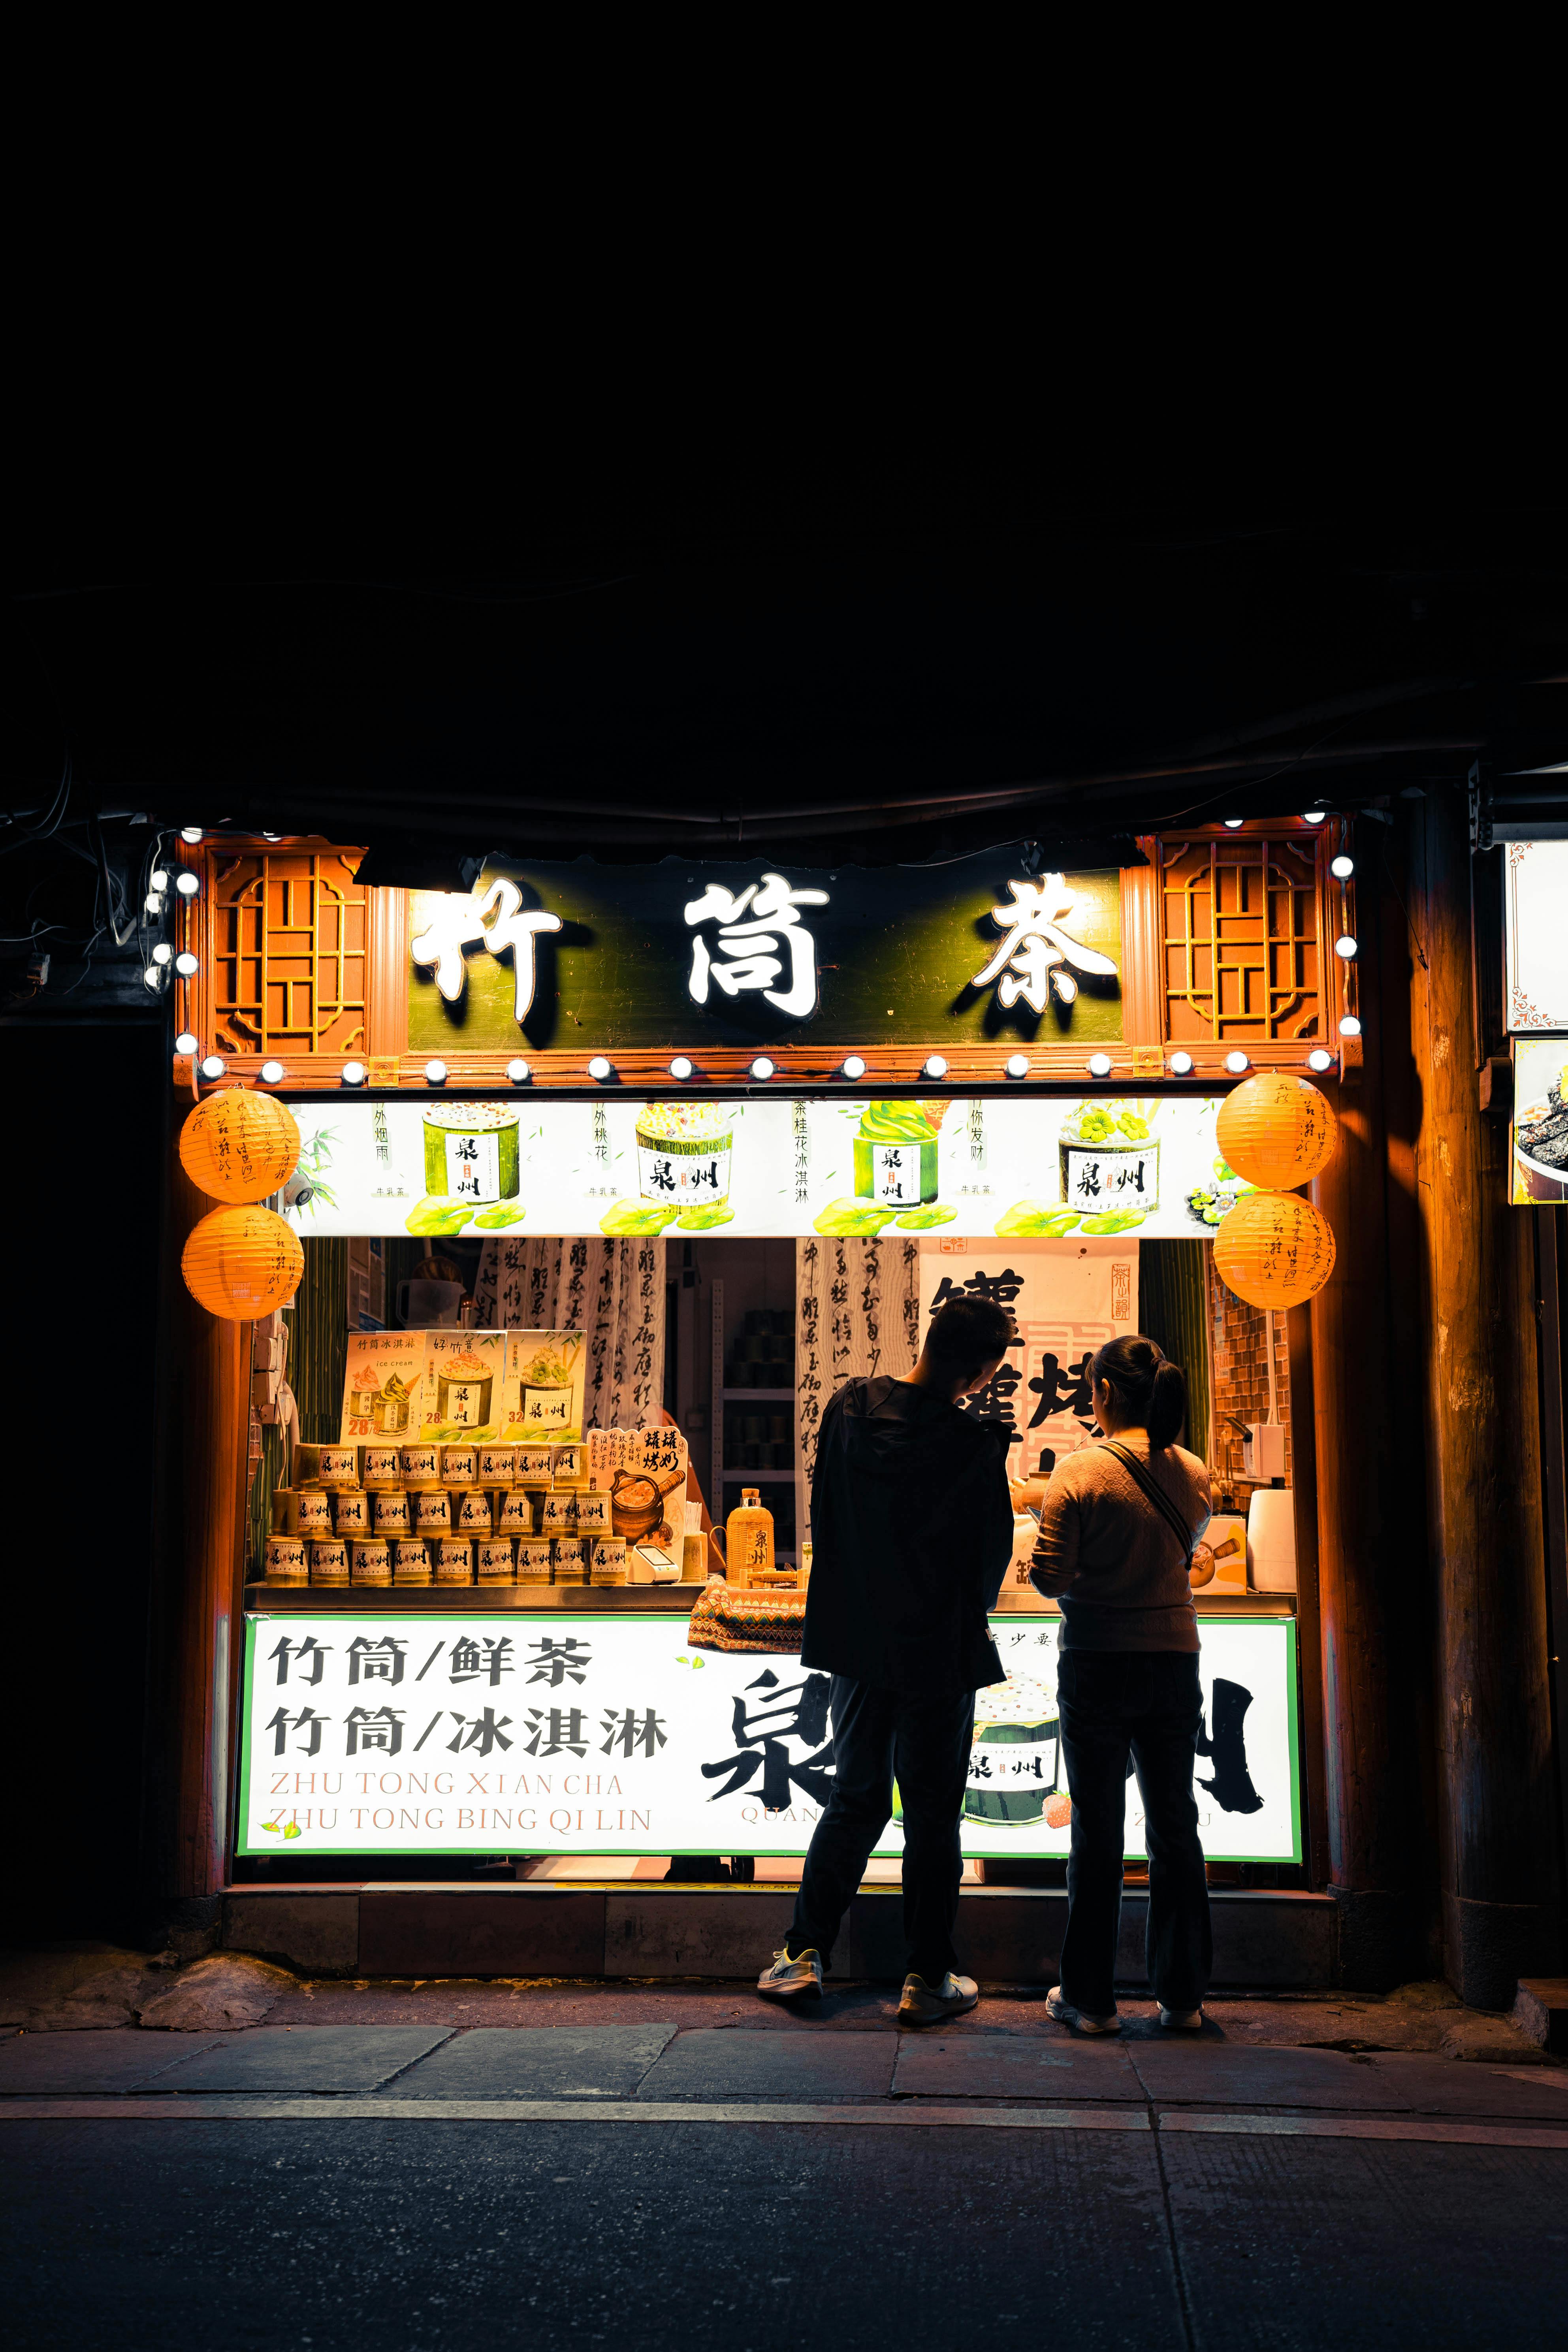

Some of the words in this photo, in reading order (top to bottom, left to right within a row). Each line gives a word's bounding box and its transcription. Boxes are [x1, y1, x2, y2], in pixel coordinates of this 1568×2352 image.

[410, 872, 1119, 1023] 竹筒茶
[375, 1103, 388, 1161] 外烟雨
[594, 1103, 608, 1161] 外桃花
[794, 1101, 809, 1203] 茶桂花冰淇淋
[455, 1138, 480, 1196] 泉州
[650, 1159, 718, 1191] 泉州
[881, 1149, 903, 1198] 泉州
[1077, 1161, 1144, 1196] 泉州
[377, 1188, 404, 1196] 牛乳茶
[589, 1188, 617, 1196] 牛乳茶
[962, 1185, 990, 1194] 牛乳茶
[357, 1338, 415, 1350] 竹筒冰淇淋
[433, 1338, 473, 1354] 好竹意
[454, 1387, 469, 1422] 泉州
[529, 1403, 566, 1418] 泉州
[322, 1456, 353, 1472] 泉州
[404, 1455, 435, 1473] 泉州
[482, 1456, 514, 1473] 泉州
[518, 1456, 550, 1473] 泉州
[555, 1546, 585, 1563] 泉州
[751, 1530, 767, 1564] 泉州
[270, 1548, 304, 1565] 泉州
[312, 1550, 344, 1566] 泉州
[356, 1552, 390, 1569] 泉州
[481, 1548, 514, 1567] 泉州
[519, 1550, 552, 1567] 泉州
[594, 1548, 625, 1566] 泉州
[268, 1636, 593, 1687] 竹筒/鲜茶
[265, 1706, 668, 1758] 竹筒/冰淇淋
[968, 1755, 1043, 1779] 泉州
[271, 1773, 343, 1794] ZHU
[356, 1773, 455, 1794] TONG
[466, 1773, 553, 1794] XIAN
[564, 1775, 623, 1794] CHA
[269, 1808, 338, 1829] ZHU
[350, 1808, 445, 1829] TONG
[457, 1808, 538, 1829] BING
[741, 1807, 819, 1824] QUAN
